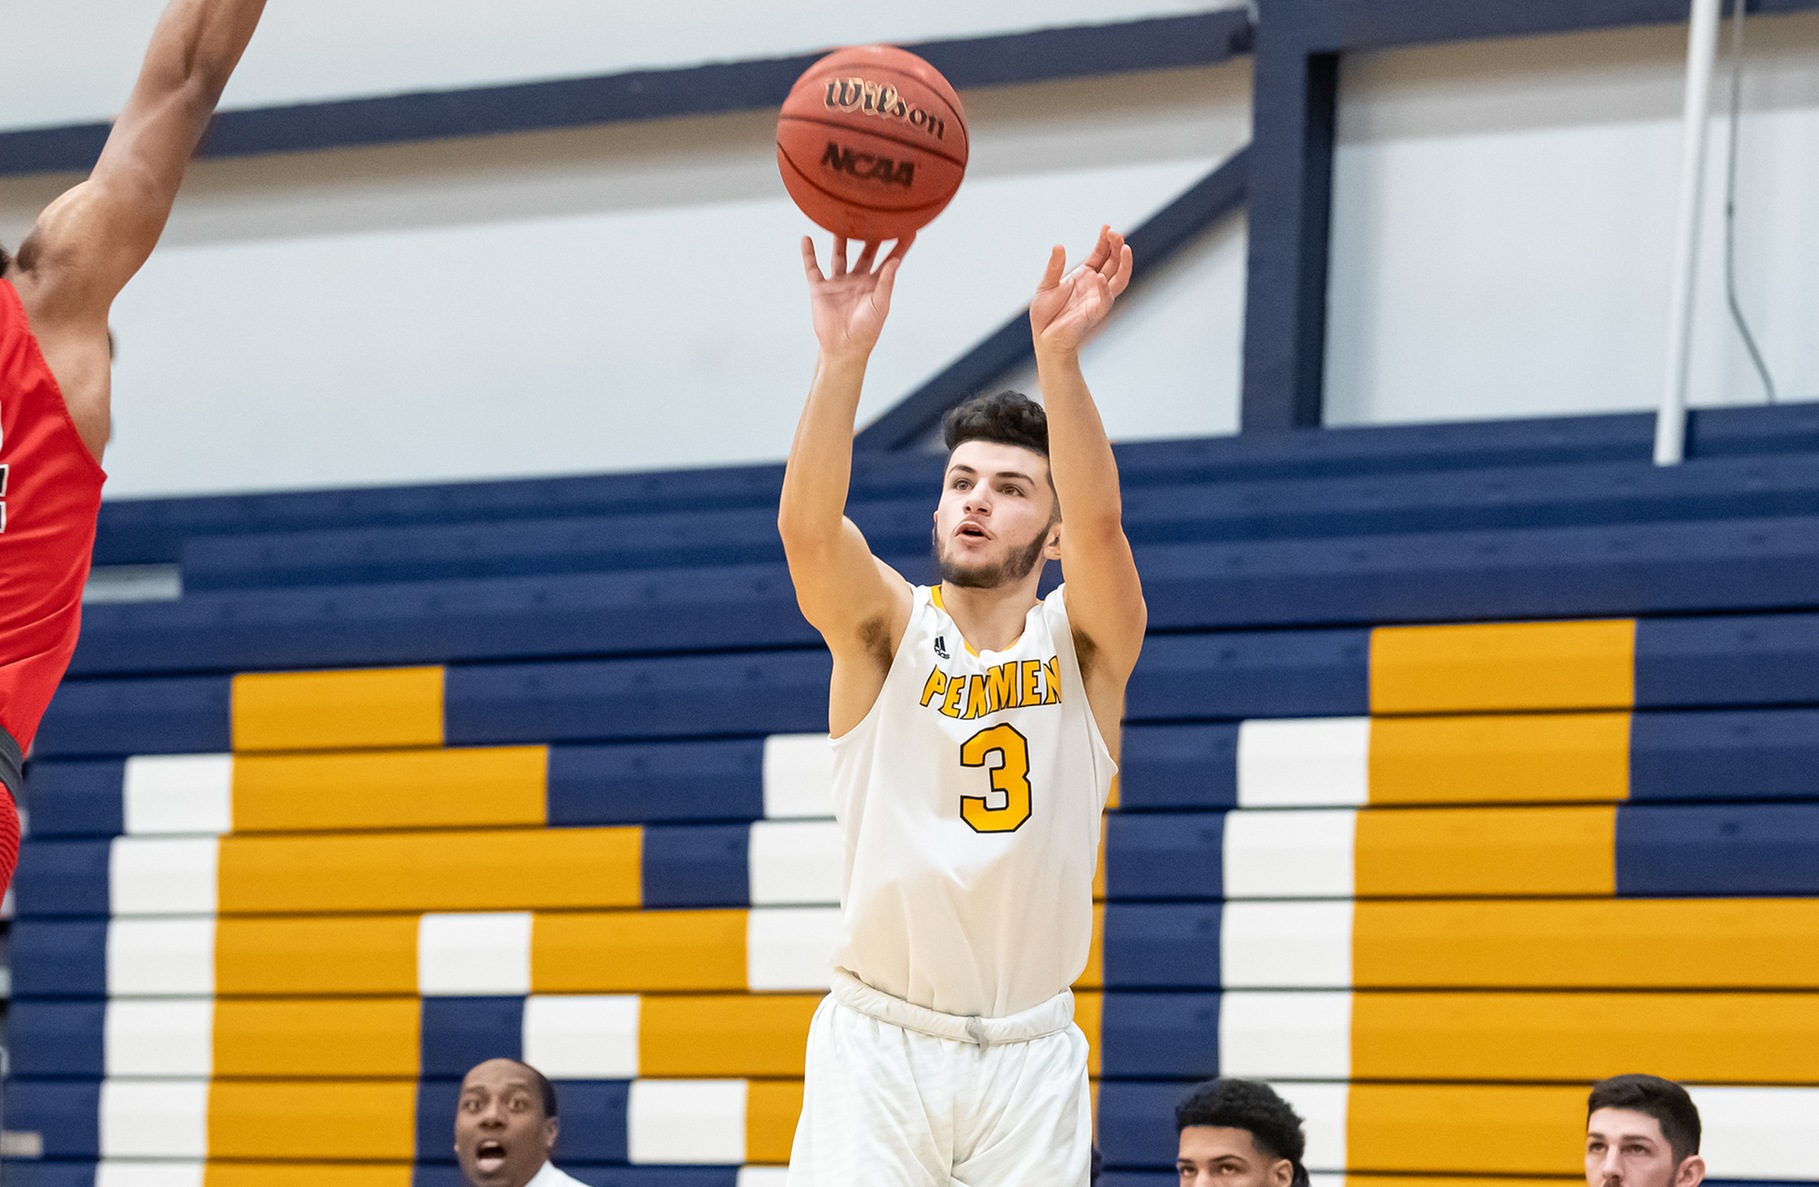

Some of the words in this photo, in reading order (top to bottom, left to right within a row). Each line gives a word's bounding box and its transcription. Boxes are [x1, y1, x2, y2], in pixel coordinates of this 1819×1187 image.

[824, 78, 945, 140] Wilson
[821, 141, 915, 188] NCAA
[919, 655, 1062, 720] PENMEN
[960, 723, 1032, 833] 3
